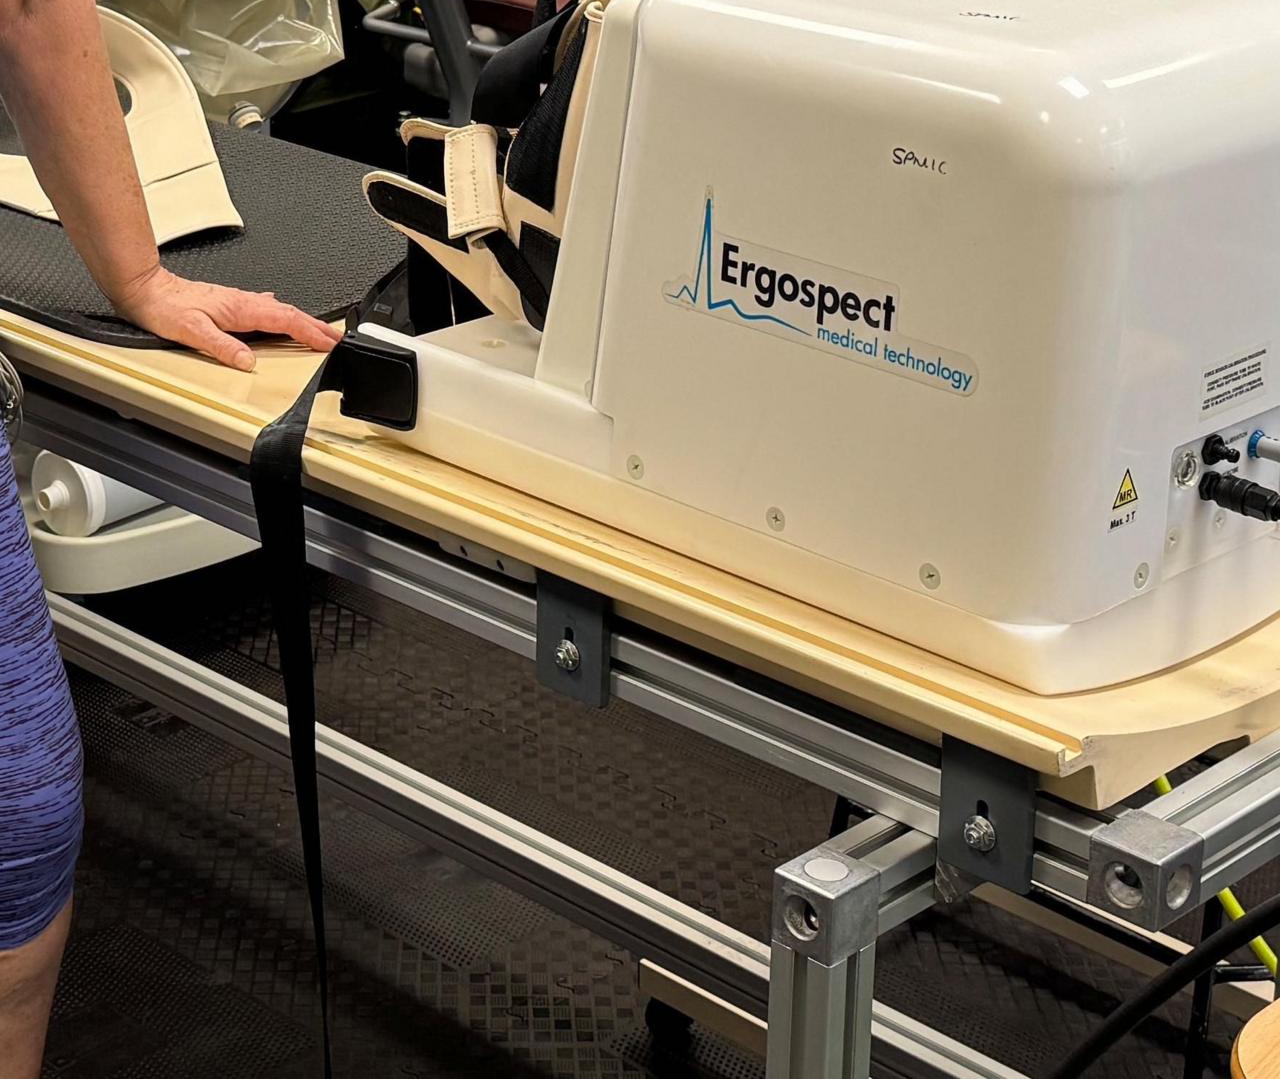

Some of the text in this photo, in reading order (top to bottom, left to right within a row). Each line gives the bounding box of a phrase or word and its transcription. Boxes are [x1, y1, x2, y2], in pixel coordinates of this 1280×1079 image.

[720, 242, 896, 332] Ergospect
[817, 326, 973, 391] medical technology
[1119, 488, 1133, 502] MR
